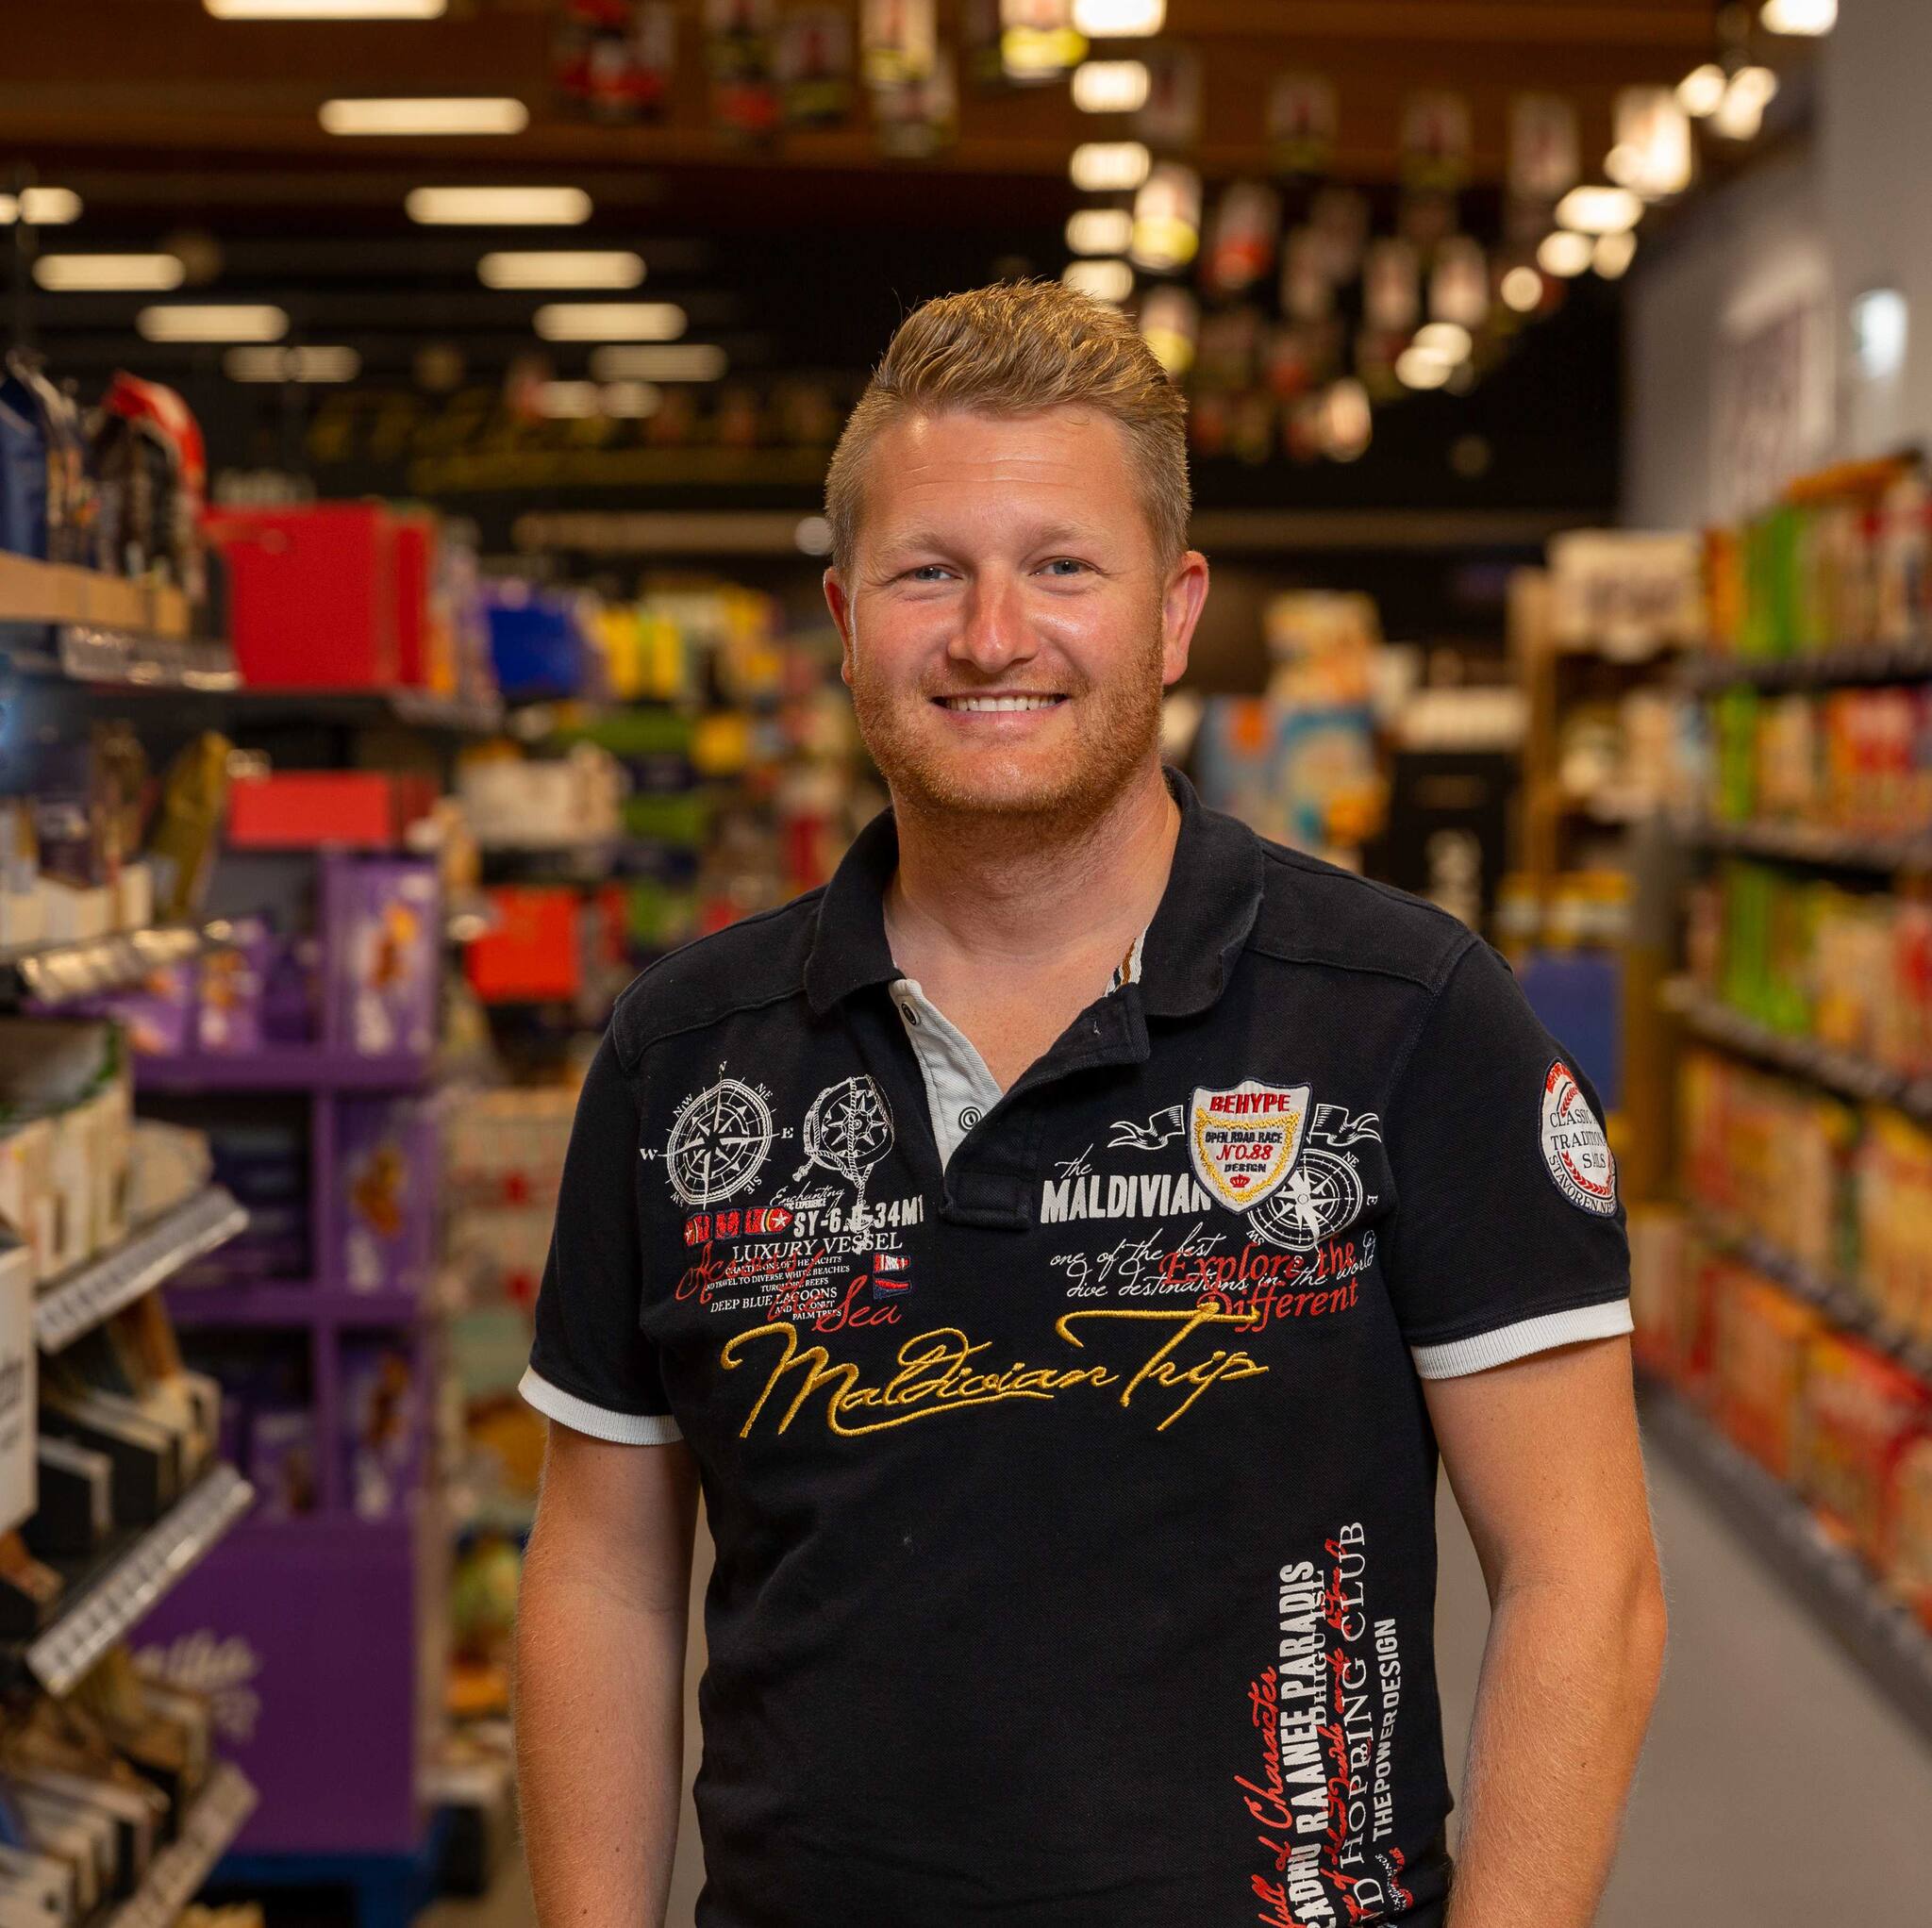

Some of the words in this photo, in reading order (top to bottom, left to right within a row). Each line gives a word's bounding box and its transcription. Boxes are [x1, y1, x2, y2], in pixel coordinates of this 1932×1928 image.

[1208, 1093, 1291, 1114] BEHYPE
[780, 1126, 794, 1139] E
[1205, 1132, 1226, 1143] OPEN
[1230, 1132, 1256, 1143] ROAD
[1257, 1133, 1284, 1144] RACE
[640, 1149, 659, 1161] W
[1054, 1142, 1093, 1179] the
[1342, 1151, 1359, 1168] NE
[1224, 1163, 1267, 1172] DESIGN
[769, 1181, 845, 1218] Enchanting
[1366, 1194, 1378, 1206] E
[732, 1237, 818, 1263] LUXURY
[823, 1231, 903, 1255] VESSEL
[1158, 1240, 1305, 1291] Explore
[1318, 1235, 1357, 1276] the
[739, 1276, 751, 1285] TO
[752, 1271, 785, 1284] DIVERSE
[812, 1265, 850, 1276] BEACHES
[805, 1276, 829, 1288] REEFS
[710, 1298, 741, 1314] DEEP
[741, 1295, 773, 1309] BLUE
[812, 1274, 902, 1334] Sea
[1196, 1277, 1359, 1333] Different
[792, 1311, 815, 1321] PALM
[1055, 1302, 1269, 1431] Trip
[1339, 1521, 1367, 1642] CLUB
[1278, 1560, 1317, 1700] PARADIS
[1233, 1663, 1293, 1830] Character
